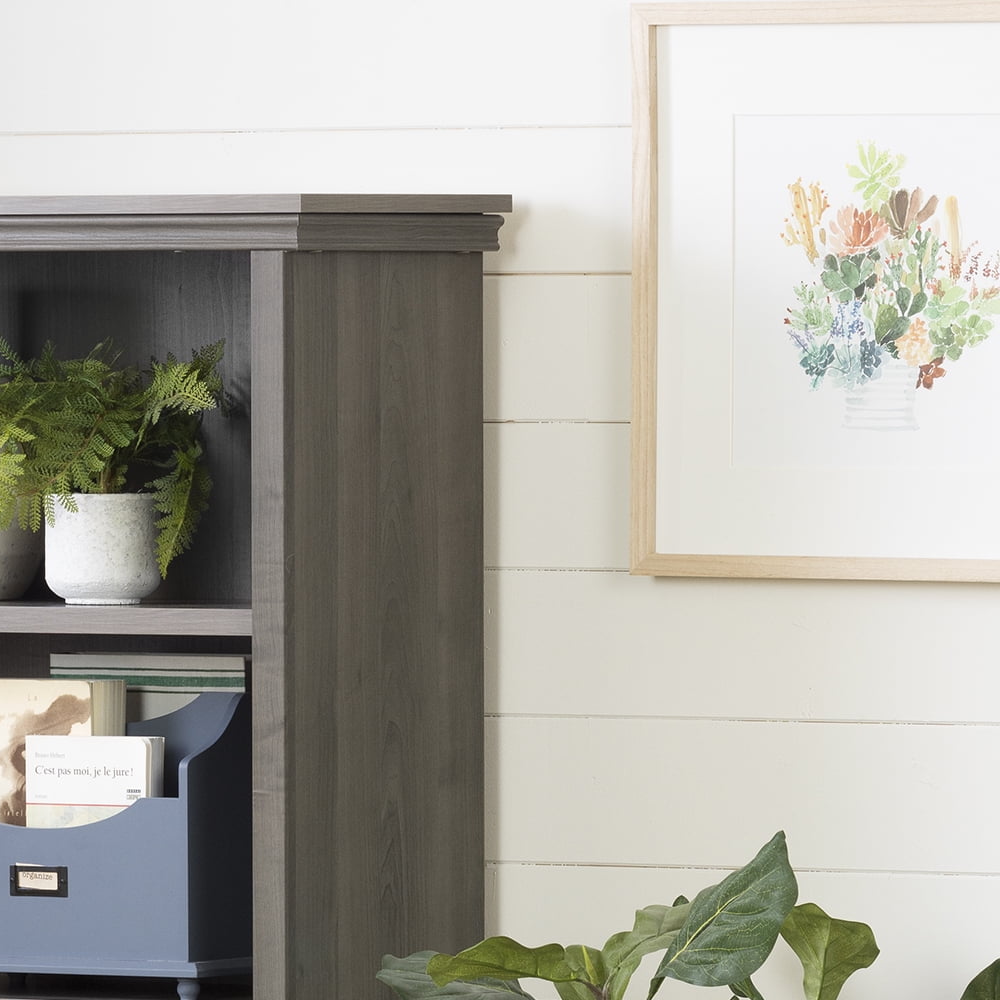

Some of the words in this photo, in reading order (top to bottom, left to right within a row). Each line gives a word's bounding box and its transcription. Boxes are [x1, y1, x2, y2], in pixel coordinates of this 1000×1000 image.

[34, 765, 55, 775] C'est
[57, 768, 71, 778] pas
[73, 767, 92, 777] moi,
[93, 767, 102, 779] je
[103, 766, 111, 776] le
[22, 872, 54, 881] organize
